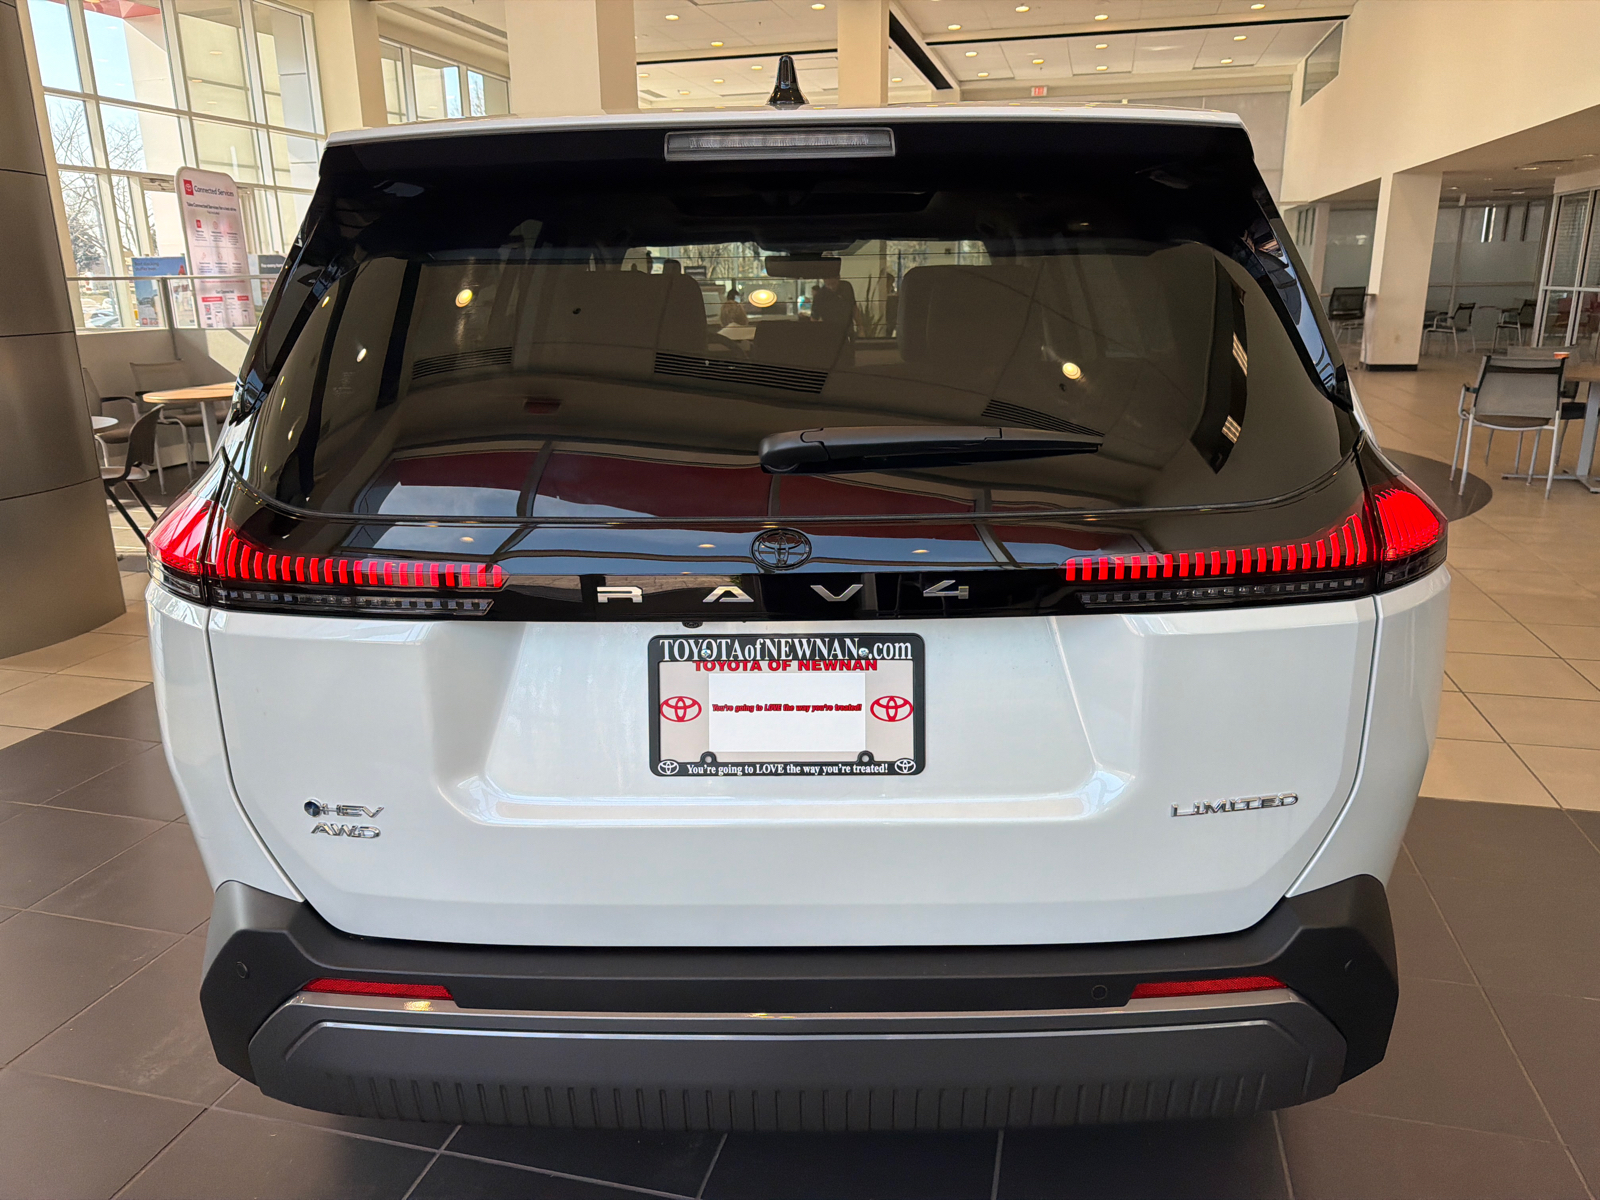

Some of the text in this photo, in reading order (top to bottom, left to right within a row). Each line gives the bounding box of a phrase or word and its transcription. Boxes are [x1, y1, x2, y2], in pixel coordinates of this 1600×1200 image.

[194, 185, 235, 197] Connected Services
[596, 579, 969, 604] RAV4
[692, 659, 878, 672] TOYOTA OF NEWNAN
[712, 704, 862, 713] You're going to LOVE the way you're treated!
[687, 763, 888, 776] You're going to LOVE the way you're treated!
[1170, 791, 1299, 818] LIMITED
[310, 822, 382, 839] AWD
